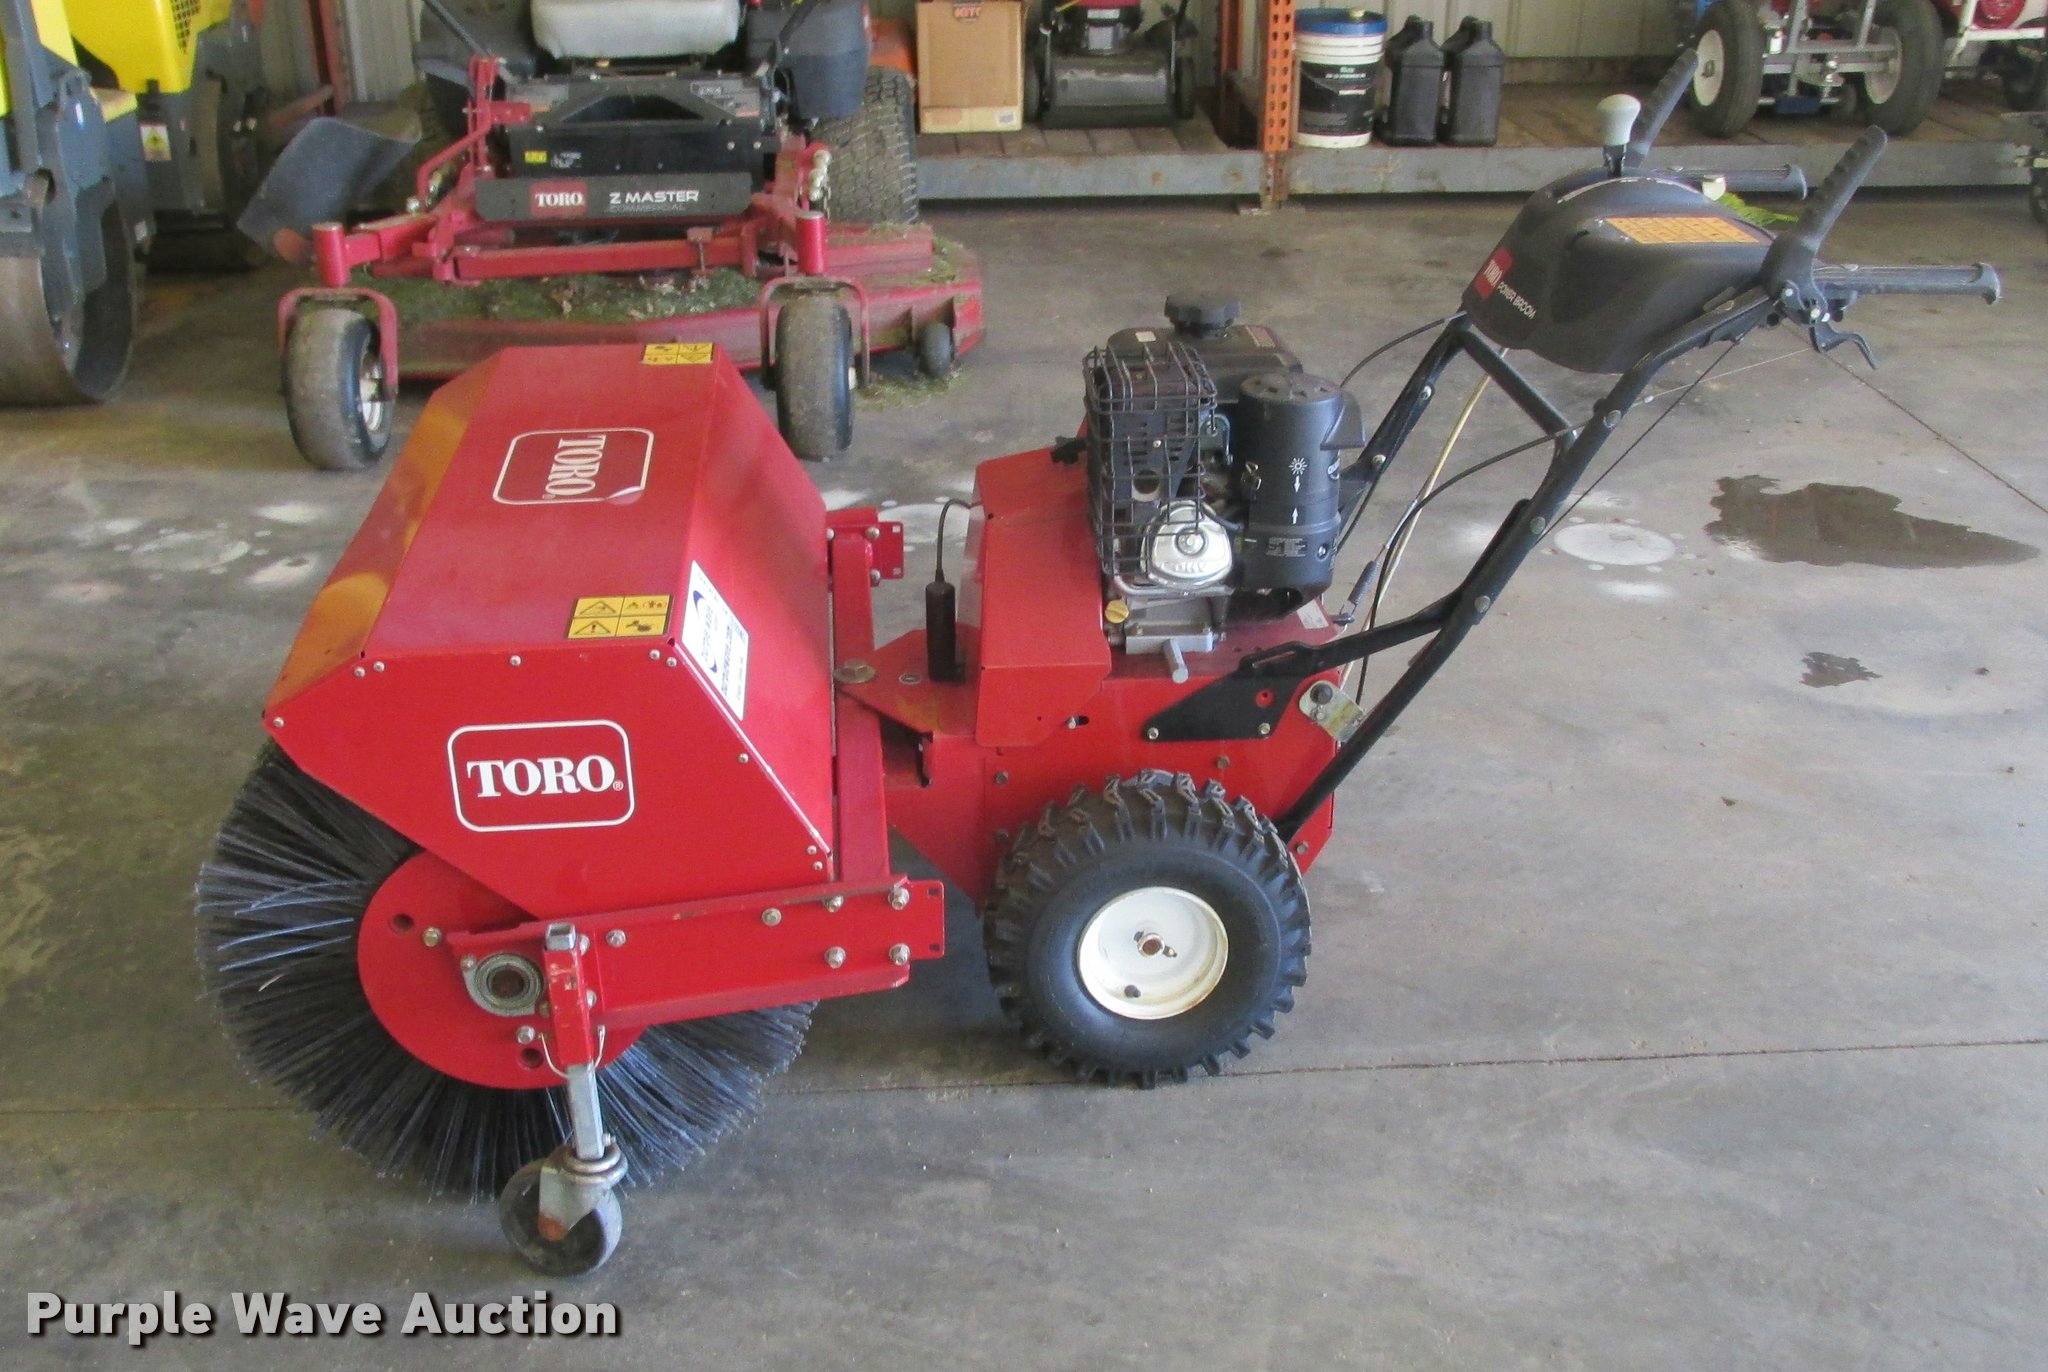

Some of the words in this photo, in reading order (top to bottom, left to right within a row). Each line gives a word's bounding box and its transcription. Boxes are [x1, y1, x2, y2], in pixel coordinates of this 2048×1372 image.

[535, 192, 585, 207] TORO
[609, 192, 621, 204] Z
[625, 190, 700, 204] MASTER
[1483, 259, 1503, 289] TORO
[1497, 281, 1517, 302] POWER
[1512, 295, 1537, 319] BROOM
[545, 434, 606, 496] TORO
[466, 755, 616, 798] TORO
